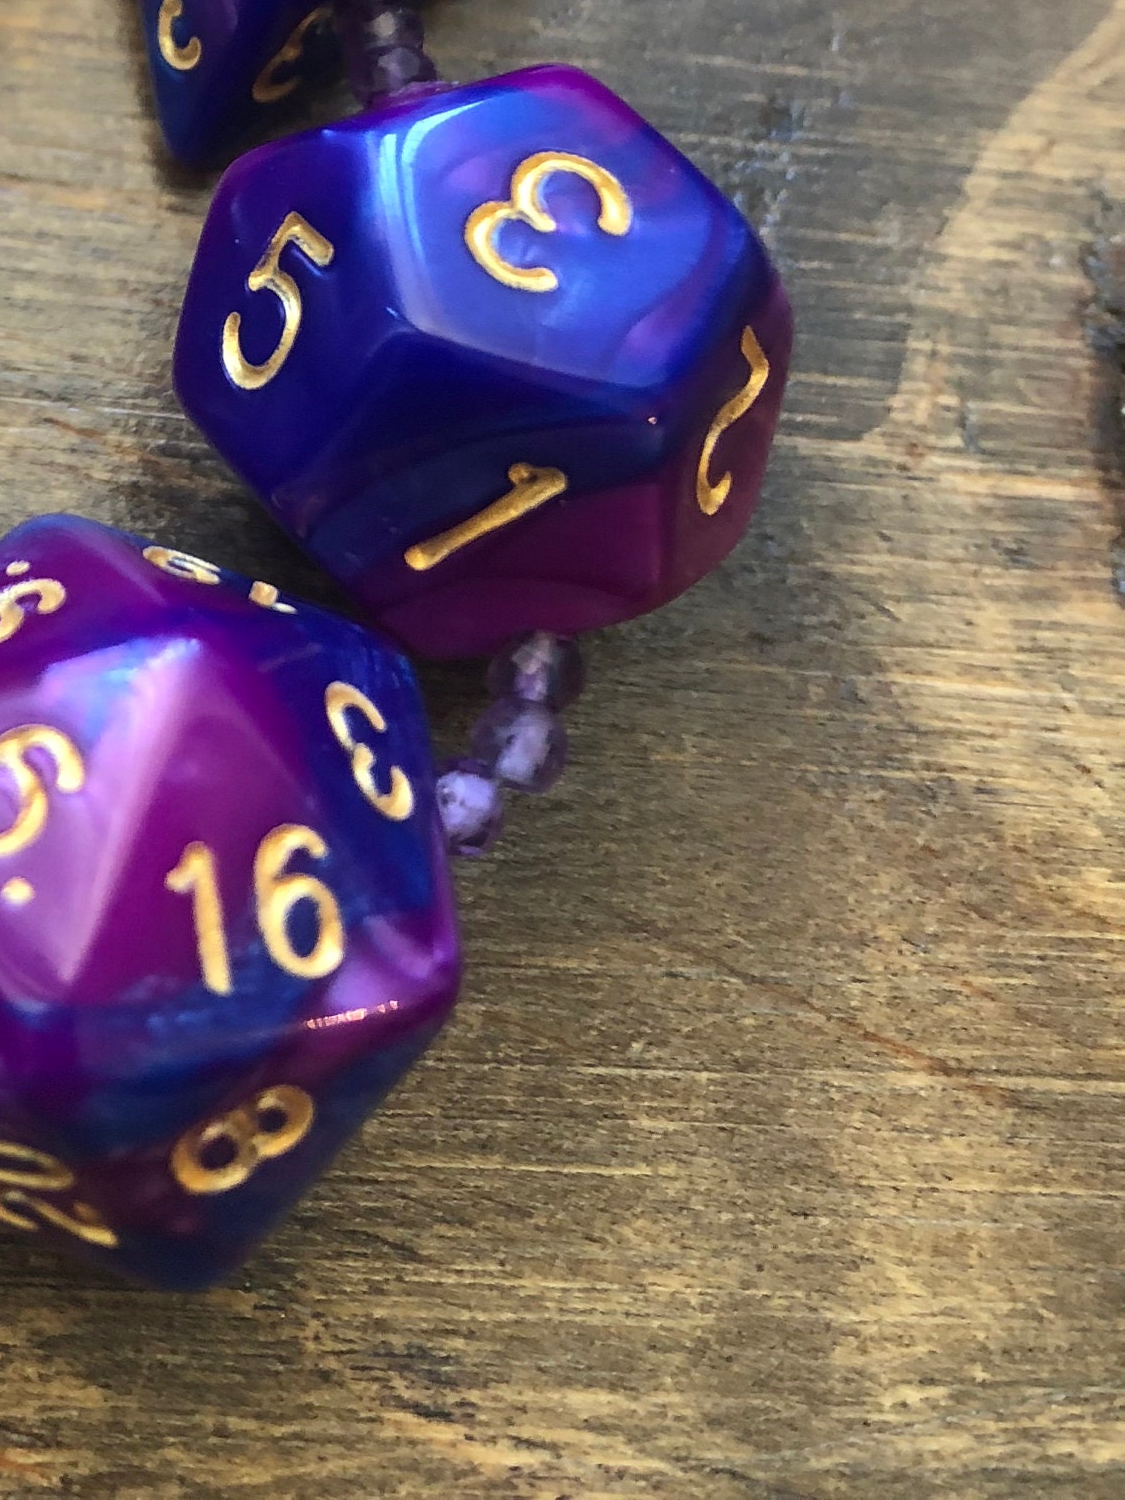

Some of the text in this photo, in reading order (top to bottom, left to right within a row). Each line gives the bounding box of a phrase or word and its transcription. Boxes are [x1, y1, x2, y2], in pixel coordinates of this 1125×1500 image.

[464, 150, 633, 293] 3
[221, 210, 336, 391] 5
[695, 324, 770, 517] 2
[403, 461, 569, 572] 1
[323, 680, 415, 822] 3
[164, 822, 345, 996] 16
[170, 1084, 315, 1195] 8
